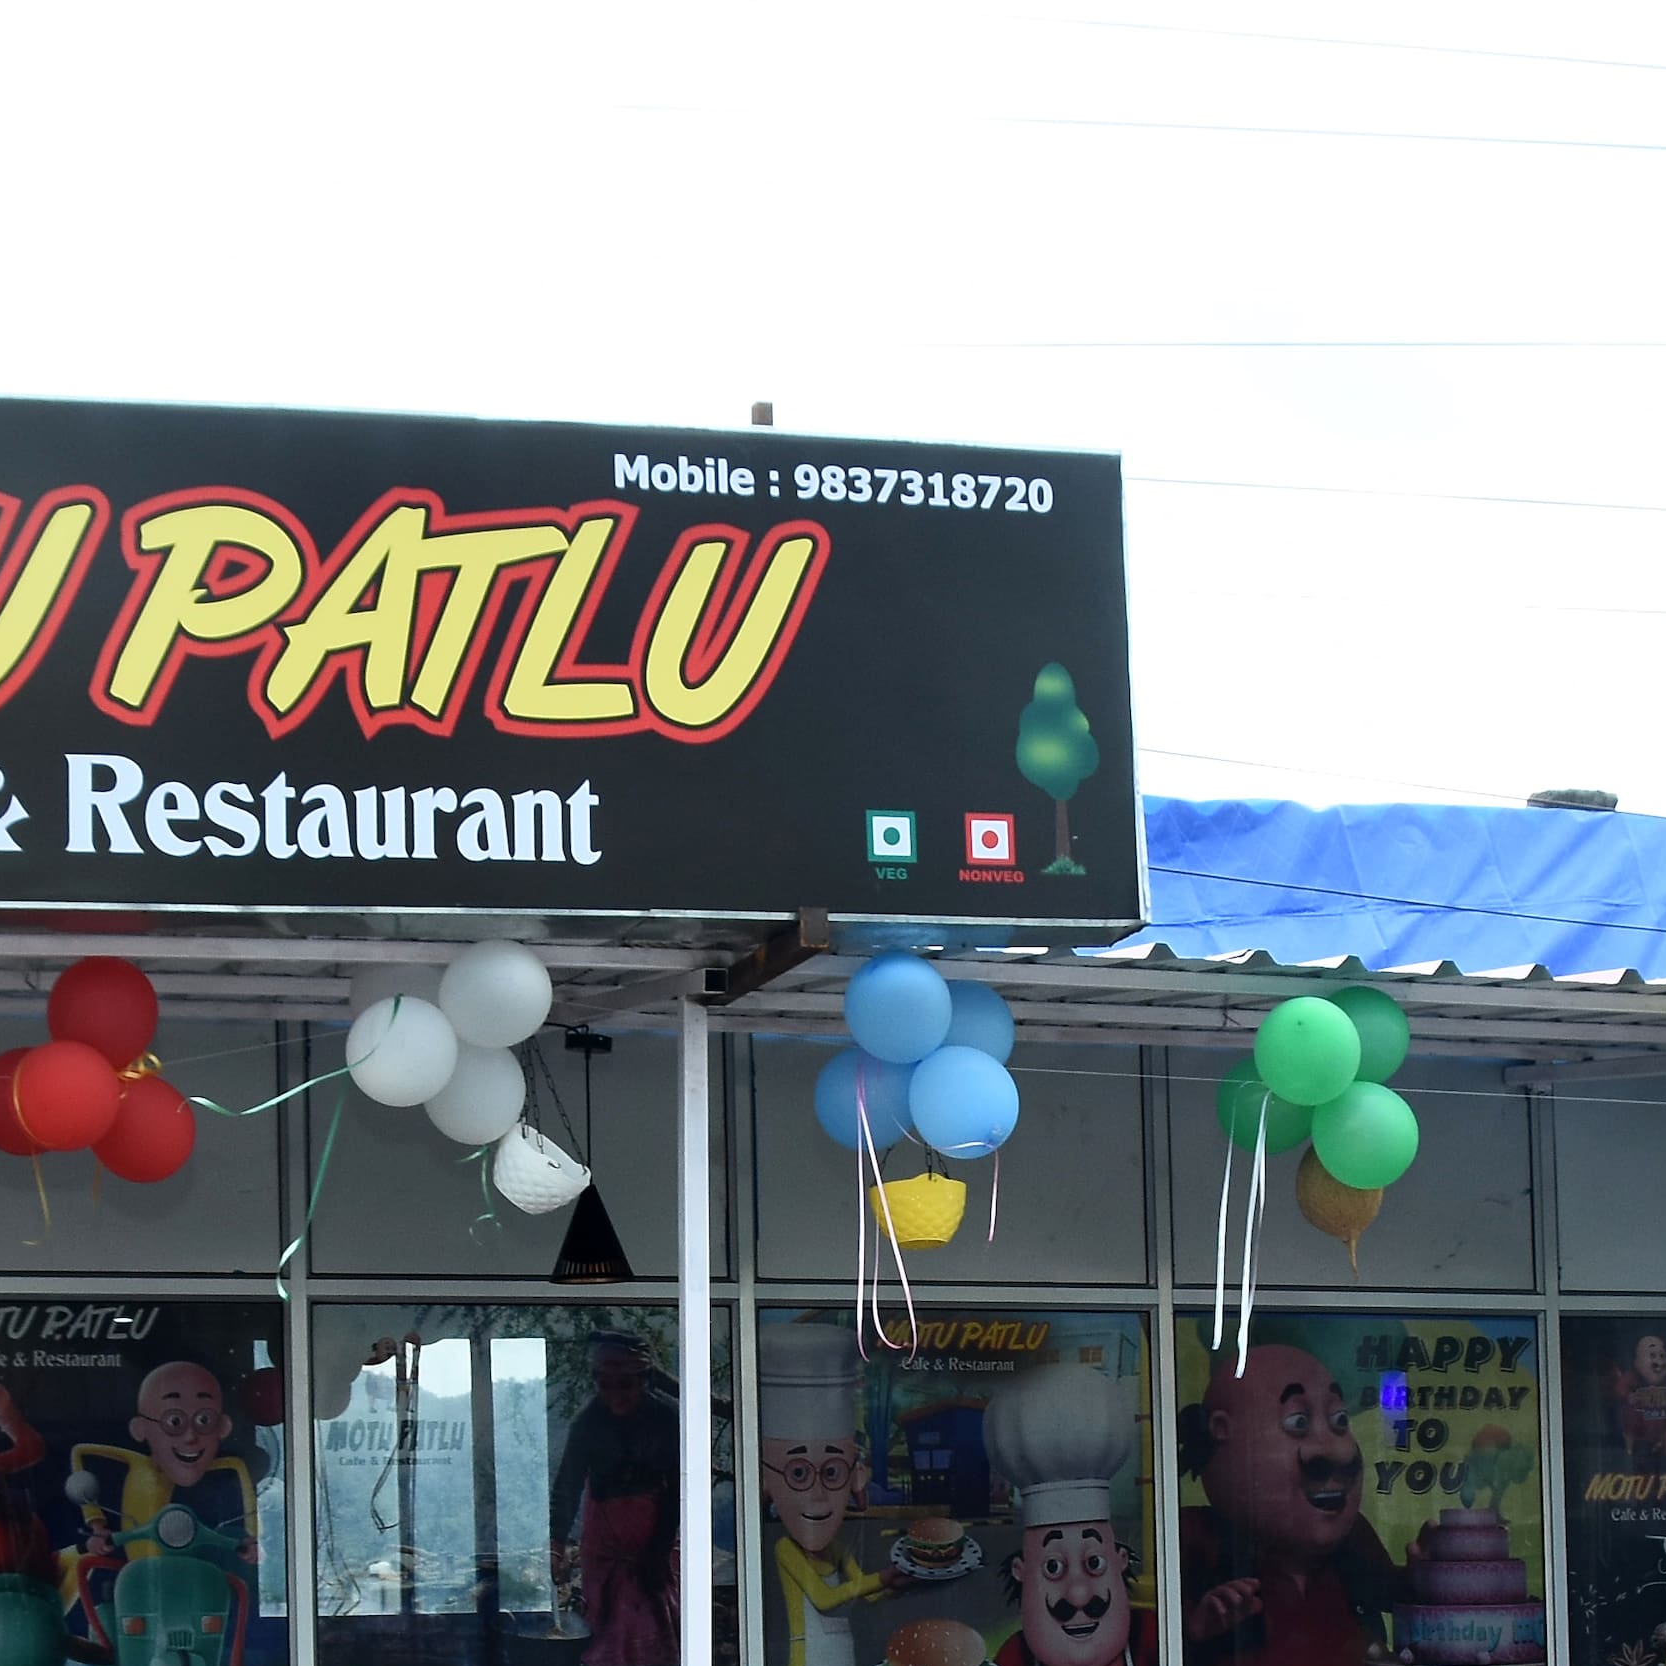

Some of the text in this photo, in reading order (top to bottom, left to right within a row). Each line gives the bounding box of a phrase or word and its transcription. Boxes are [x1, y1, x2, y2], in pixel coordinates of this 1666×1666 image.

[613, 453, 1054, 514] Mobile : 9837318720
[92, 490, 827, 740] PATLU
[64, 753, 602, 866] Restaurant
[875, 867, 1025, 883] VEG NONVEG
[41, 1303, 160, 1341] PATLU
[959, 1320, 1050, 1351] PATLU
[12, 1352, 29, 1368] &
[33, 1349, 123, 1368] Restaurant
[900, 1357, 1015, 1372] Cafe & Restaurant
[1356, 1335, 1532, 1373] HAPPY
[1360, 1385, 1530, 1411] BIRTHDAY
[326, 1418, 393, 1452] MOTU
[1392, 1418, 1450, 1453] TO
[1375, 1460, 1469, 1495] YOU
[1585, 1472, 1654, 1501] MOTU
[1611, 1508, 1637, 1522] Cafe
[1639, 1508, 1650, 1522] &
